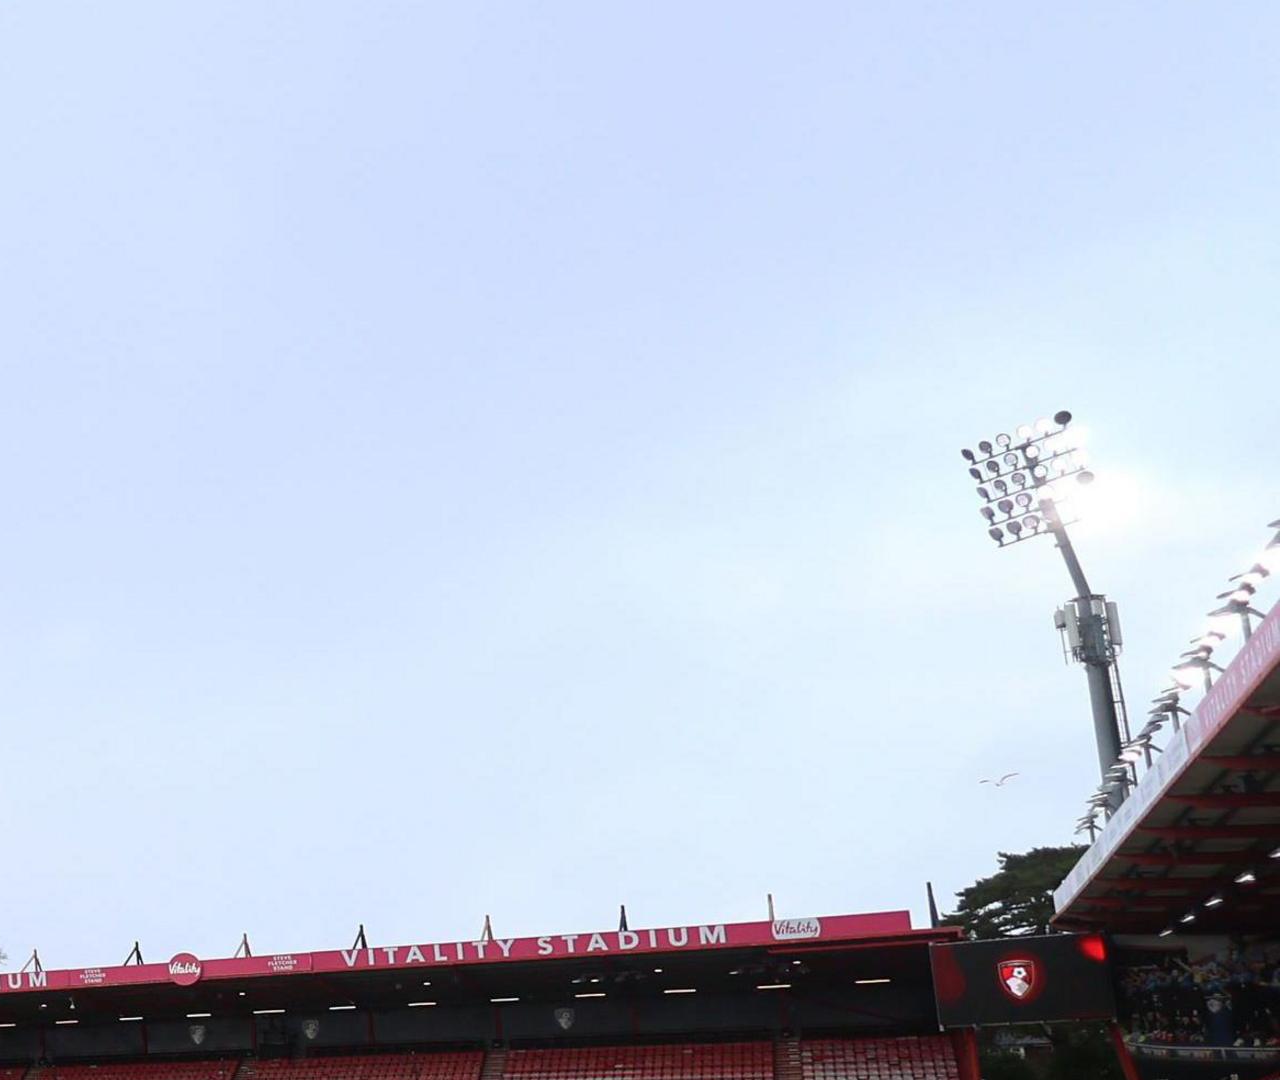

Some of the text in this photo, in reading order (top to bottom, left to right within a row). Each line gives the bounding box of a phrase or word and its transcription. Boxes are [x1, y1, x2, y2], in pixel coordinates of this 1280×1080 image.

[773, 921, 819, 938] Vitality
[341, 925, 727, 967] VITALITY STADIUM
[168, 961, 201, 976] Vitality
